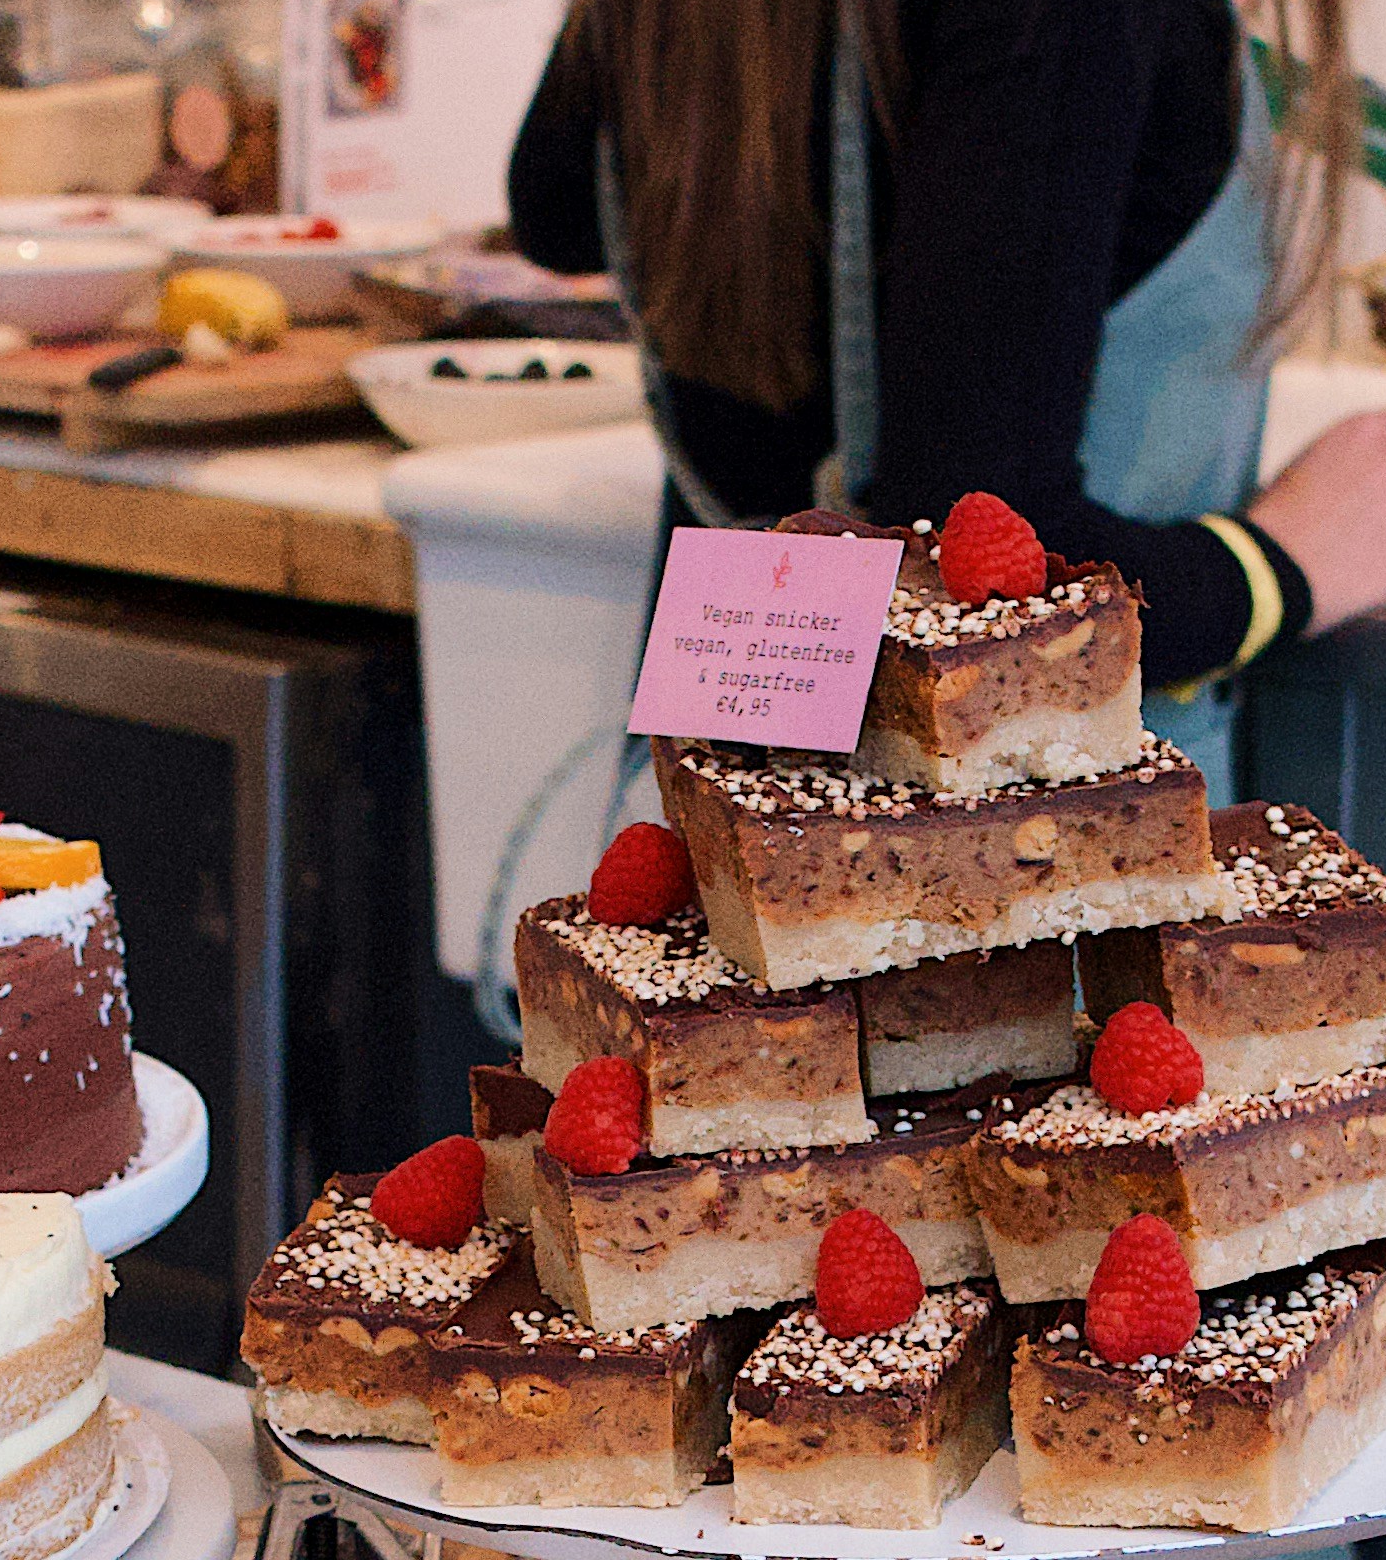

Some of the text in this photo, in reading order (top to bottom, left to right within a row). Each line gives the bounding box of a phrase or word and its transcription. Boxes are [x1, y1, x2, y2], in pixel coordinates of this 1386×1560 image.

[703, 604, 841, 631] Vegan snicker
[674, 636, 856, 664] vegan, glutenfree
[697, 668, 816, 692] & sugarfree
[716, 695, 771, 716] €4,95
